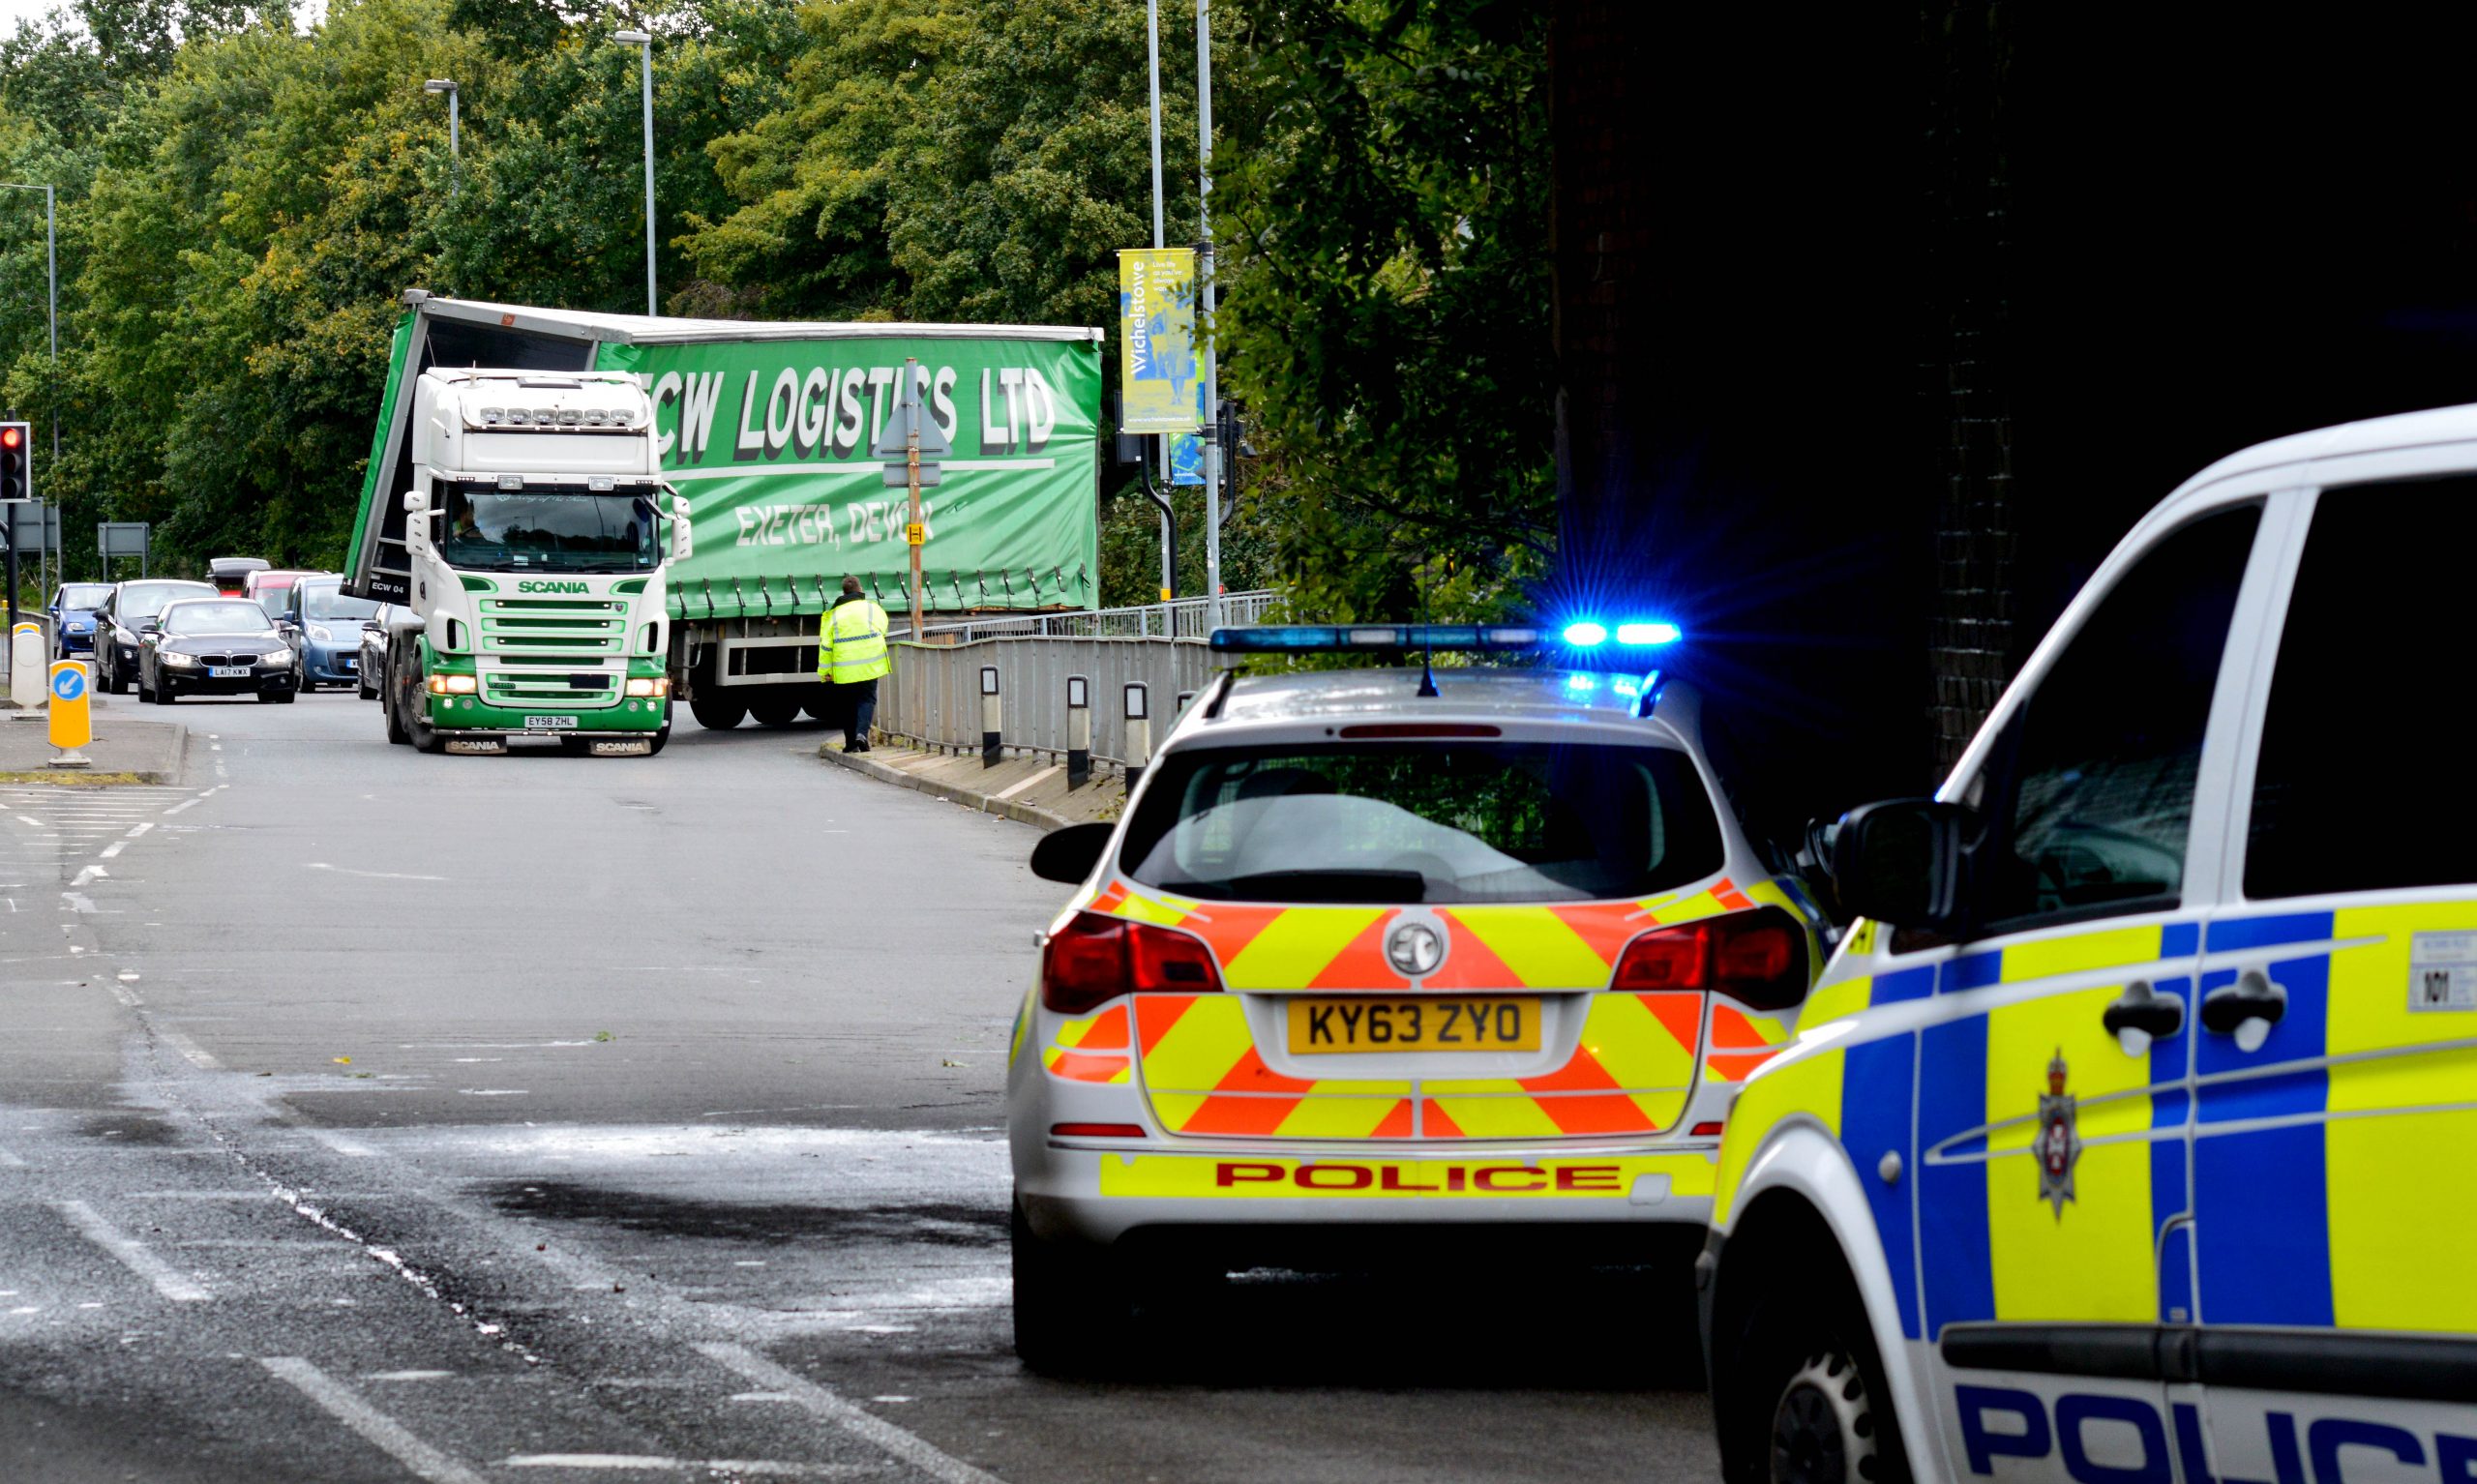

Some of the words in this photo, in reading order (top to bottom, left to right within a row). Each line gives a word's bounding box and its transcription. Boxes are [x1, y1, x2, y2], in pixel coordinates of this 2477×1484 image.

[1128, 260, 1147, 374] Wichelstowe
[980, 368, 1055, 451] LTD
[735, 503, 841, 551] EXETER,
[372, 581, 392, 592] ECW
[393, 585, 404, 594] 04
[518, 580, 590, 594] SCANIA
[215, 668, 231, 676] LA17
[528, 717, 552, 726] EY58
[555, 717, 573, 726] ZHL
[451, 740, 499, 751] SCANIA
[595, 742, 645, 753] SCANIA
[2424, 970, 2449, 1003] 101
[1308, 1004, 1422, 1045] KY63
[1437, 1003, 1520, 1043] ZYO
[1215, 1162, 1623, 1192] POLICE
[1954, 1384, 2477, 1484] POLIC
